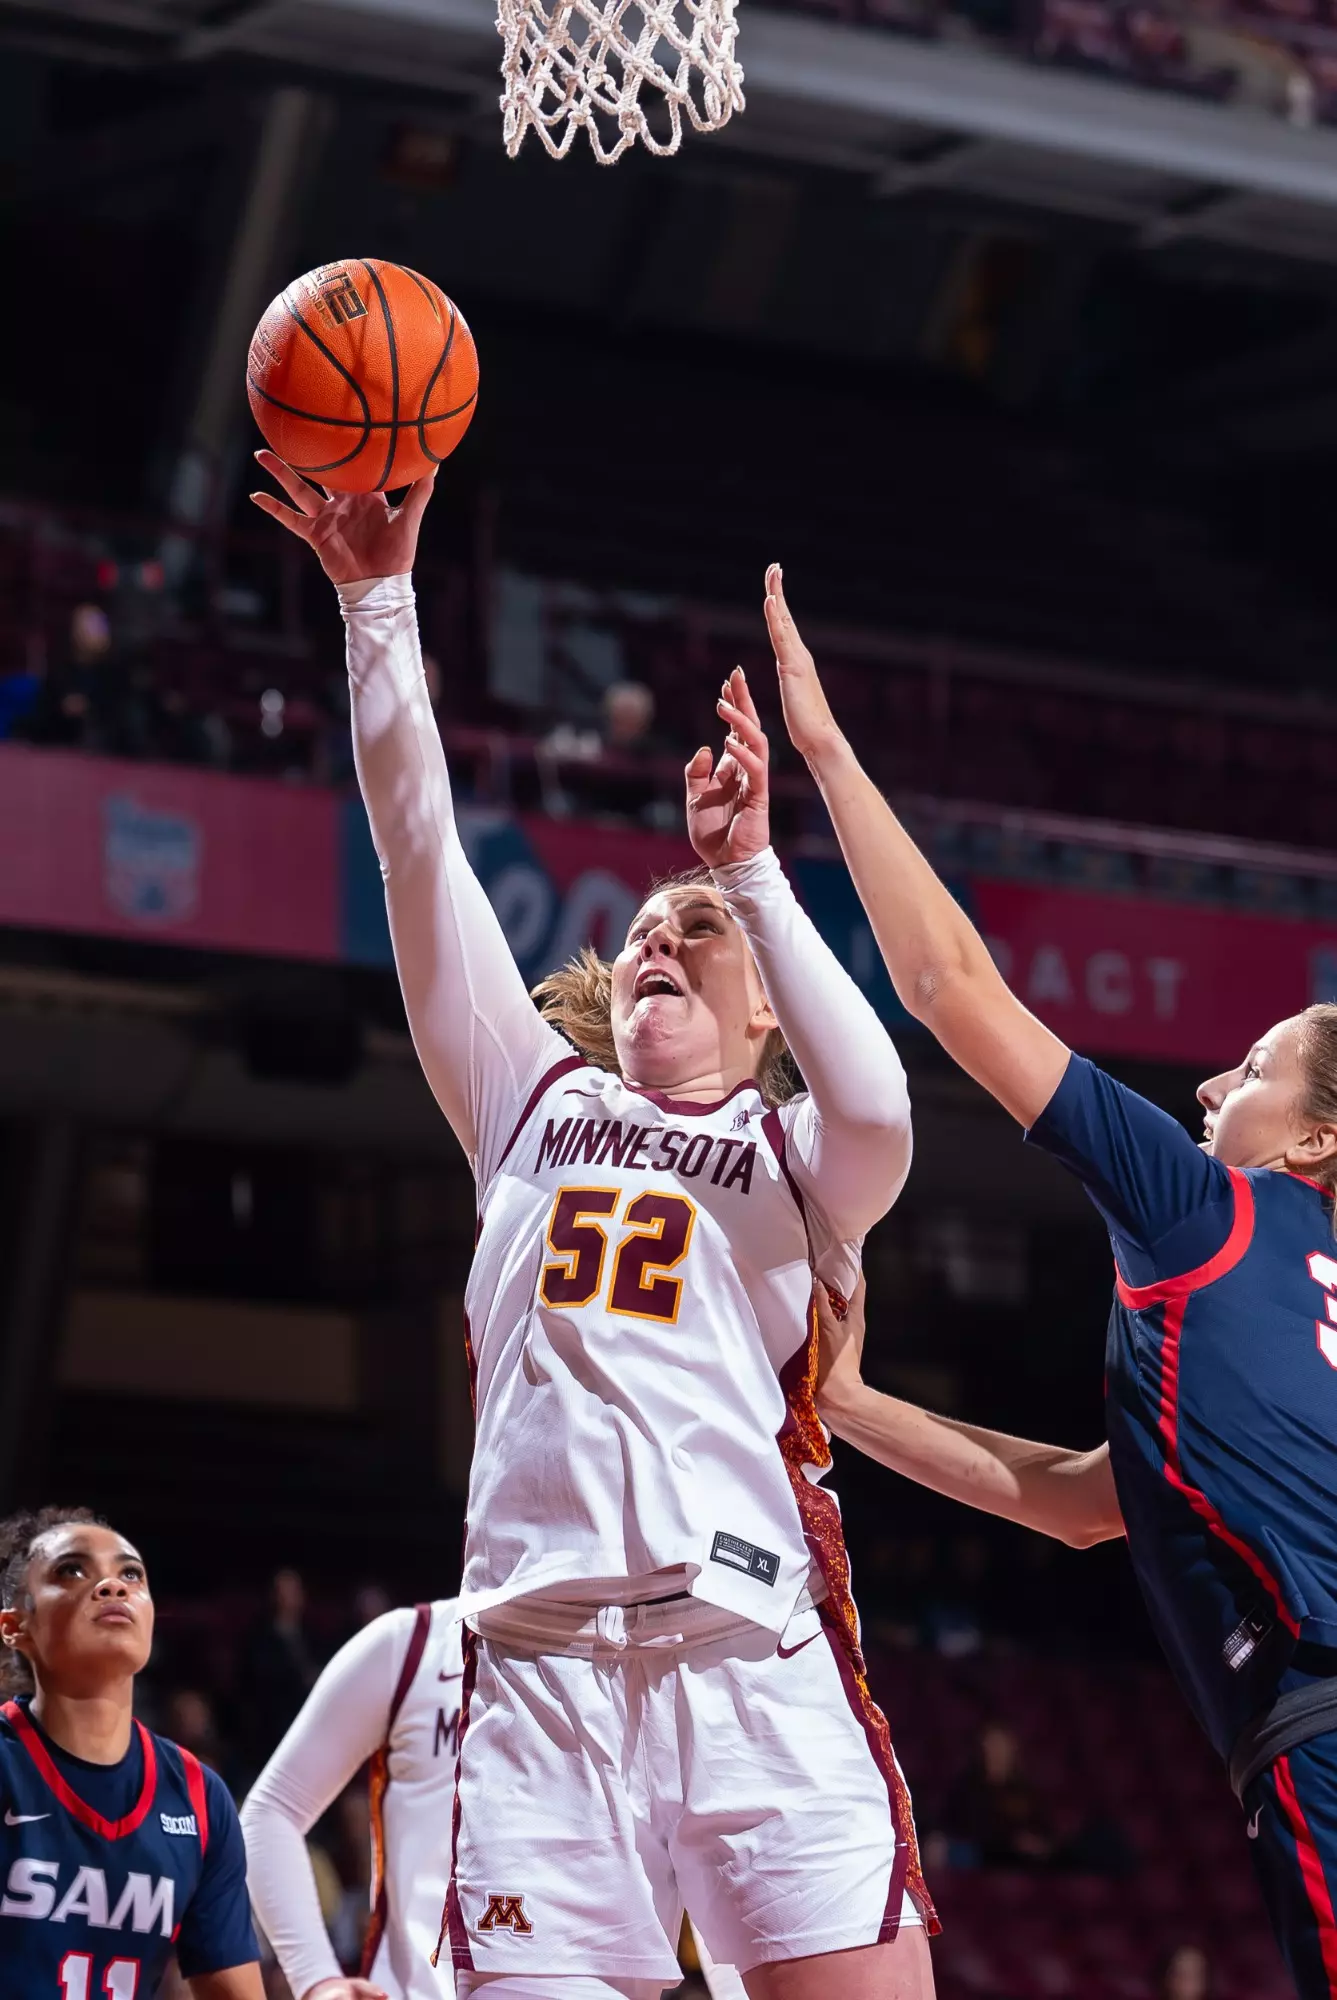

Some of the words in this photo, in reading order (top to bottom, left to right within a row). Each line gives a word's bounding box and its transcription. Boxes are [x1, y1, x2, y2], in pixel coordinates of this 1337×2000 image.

[533, 1117, 758, 1196] MINNESOTA
[539, 1185, 697, 1325] 52
[756, 1556, 770, 1573] XL
[1251, 1621, 1263, 1632] L
[0, 1857, 176, 1939] SAM
[475, 1892, 534, 1937] M
[57, 1950, 141, 2000] 11
